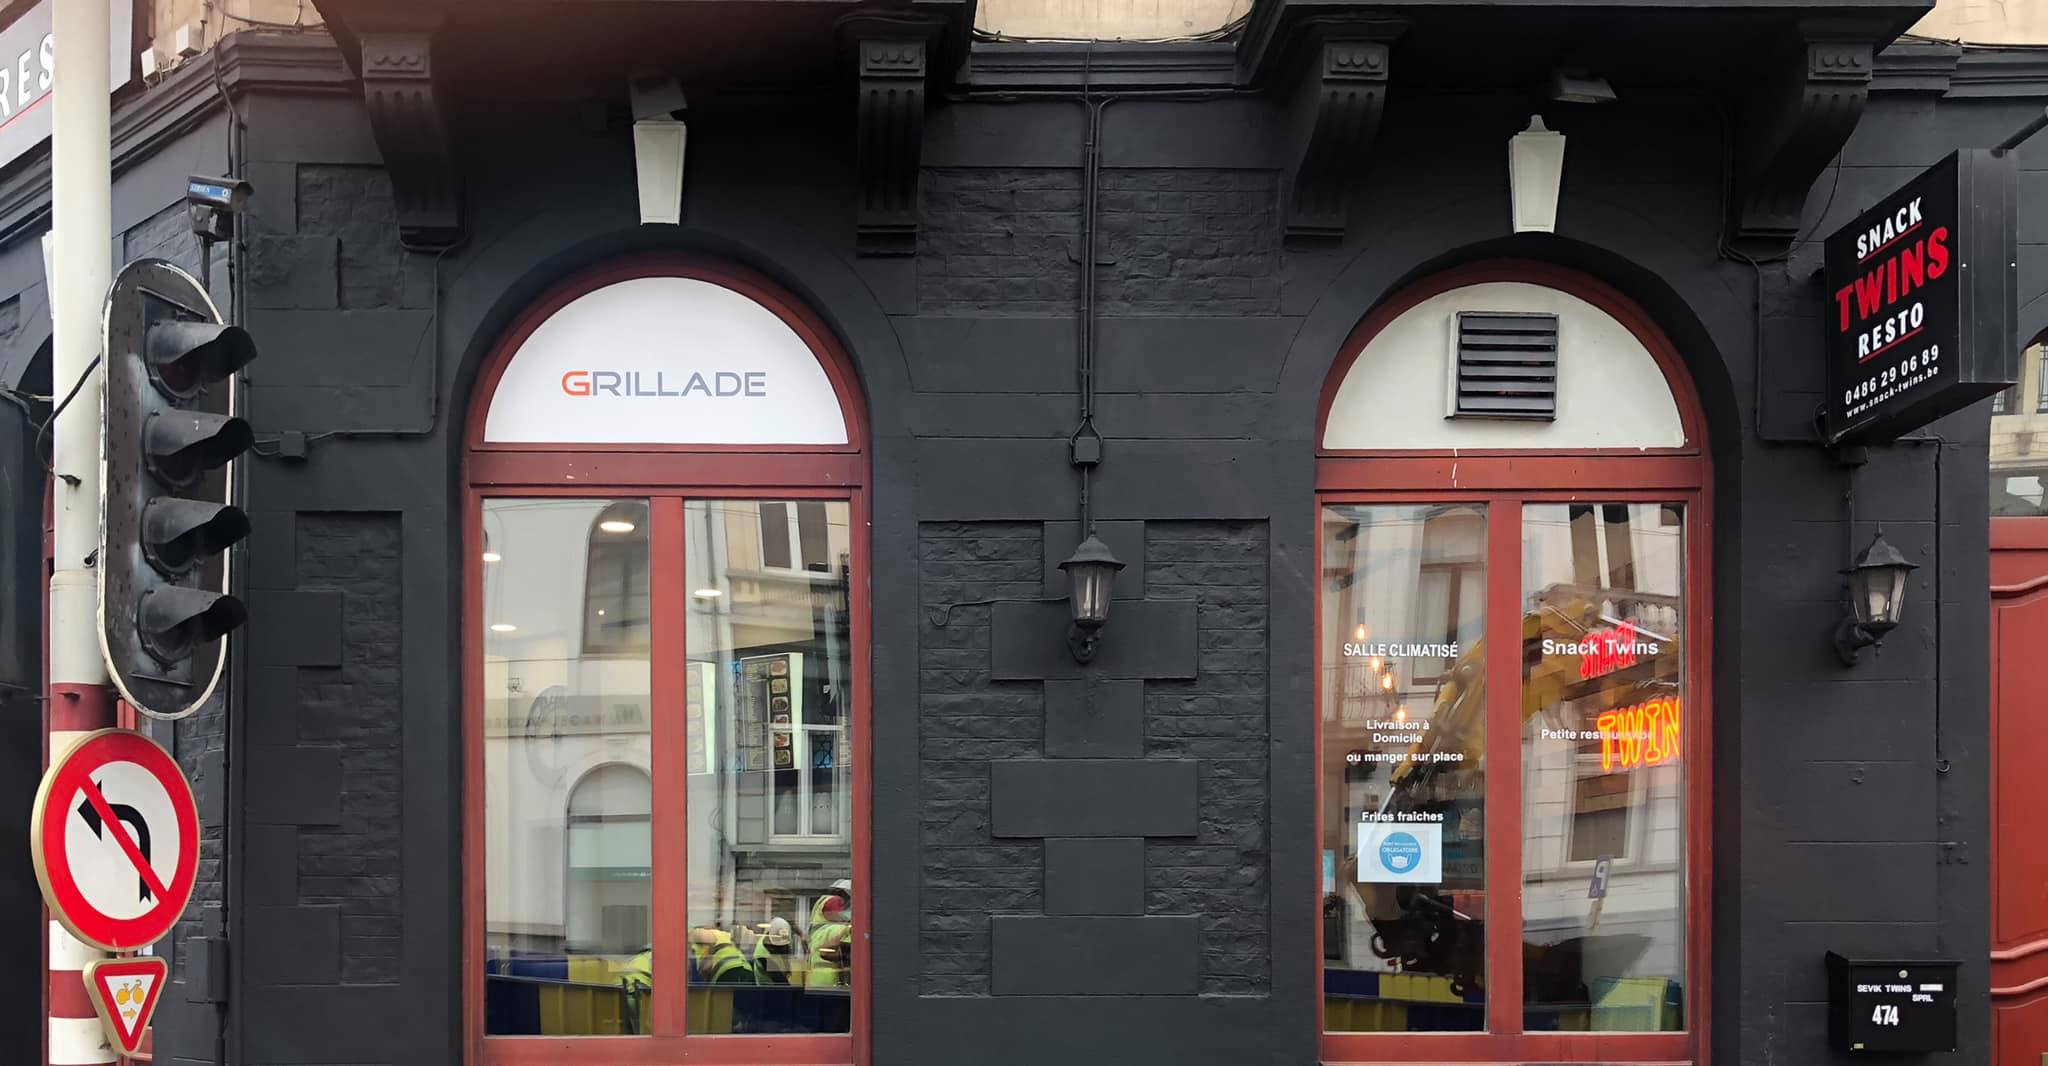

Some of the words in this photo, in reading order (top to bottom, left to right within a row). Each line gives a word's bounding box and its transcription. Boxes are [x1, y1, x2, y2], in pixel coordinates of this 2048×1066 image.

[1857, 196, 1922, 259] SNACK
[1835, 226, 1949, 332] TWINS
[1858, 302, 1924, 358] RESTO
[1845, 377, 1876, 405] 0486
[1880, 367, 1896, 387] 29
[1901, 355, 1917, 376] 06
[1922, 344, 1939, 365] 89
[561, 371, 766, 397] GRILLADE
[1846, 366, 1939, 418] www.snack-twins.be
[1343, 643, 1386, 657] SALLE
[1389, 641, 1458, 657] CLIMATISÉ
[1541, 639, 1599, 655] Snack
[1605, 639, 1659, 655] Twins
[1366, 719, 1420, 730] Livraison
[1423, 719, 1430, 730] à
[1372, 732, 1423, 743] Domicile
[1541, 728, 1577, 740] Petite
[1346, 753, 1361, 762] ou
[1364, 753, 1409, 764] manger
[1411, 753, 1430, 762] sur
[1433, 751, 1464, 763] place
[1362, 811, 1395, 822] Frites
[1857, 984, 1882, 993] SEVIK
[1885, 984, 1912, 993] TWINS
[1871, 1004, 1899, 1026] 474
